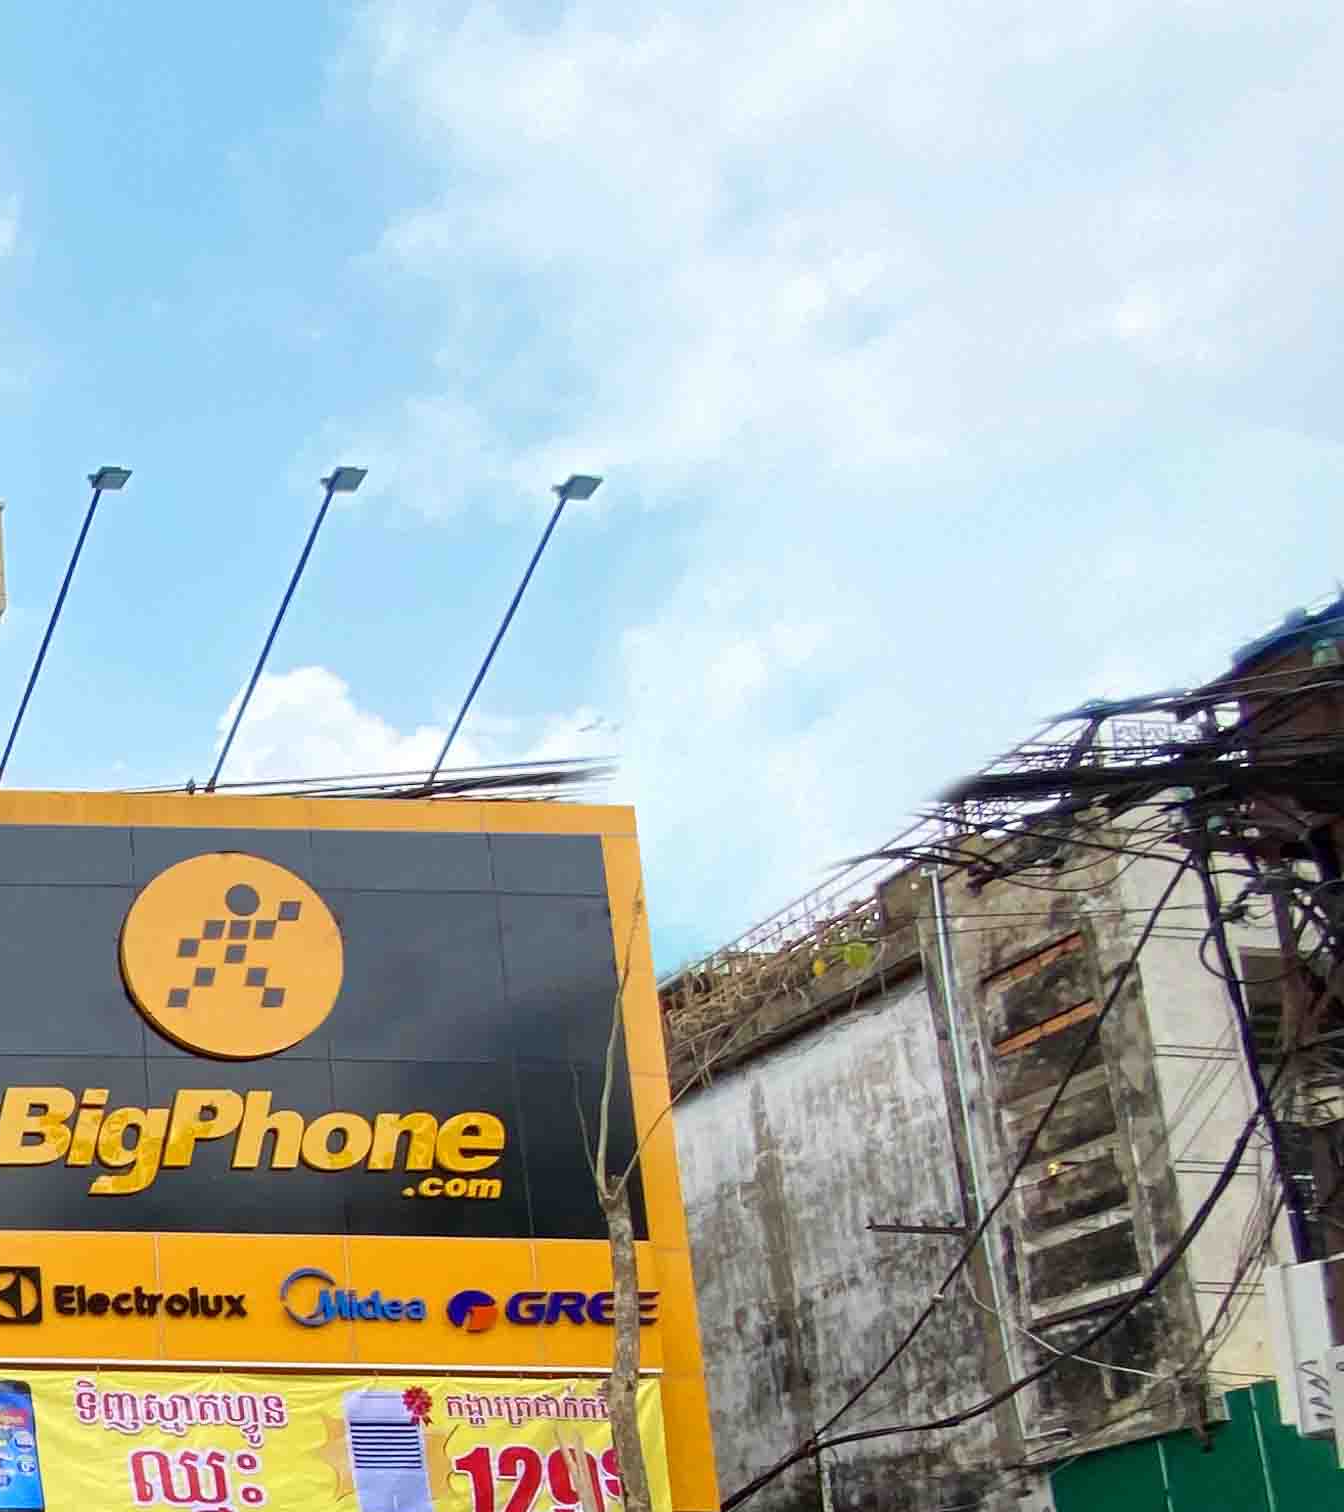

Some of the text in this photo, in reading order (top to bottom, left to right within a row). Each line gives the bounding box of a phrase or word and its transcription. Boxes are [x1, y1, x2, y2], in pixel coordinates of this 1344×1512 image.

[402, 1177, 502, 1199] .com
[53, 1284, 249, 1319] Electrolux
[316, 1288, 426, 1322] Midea
